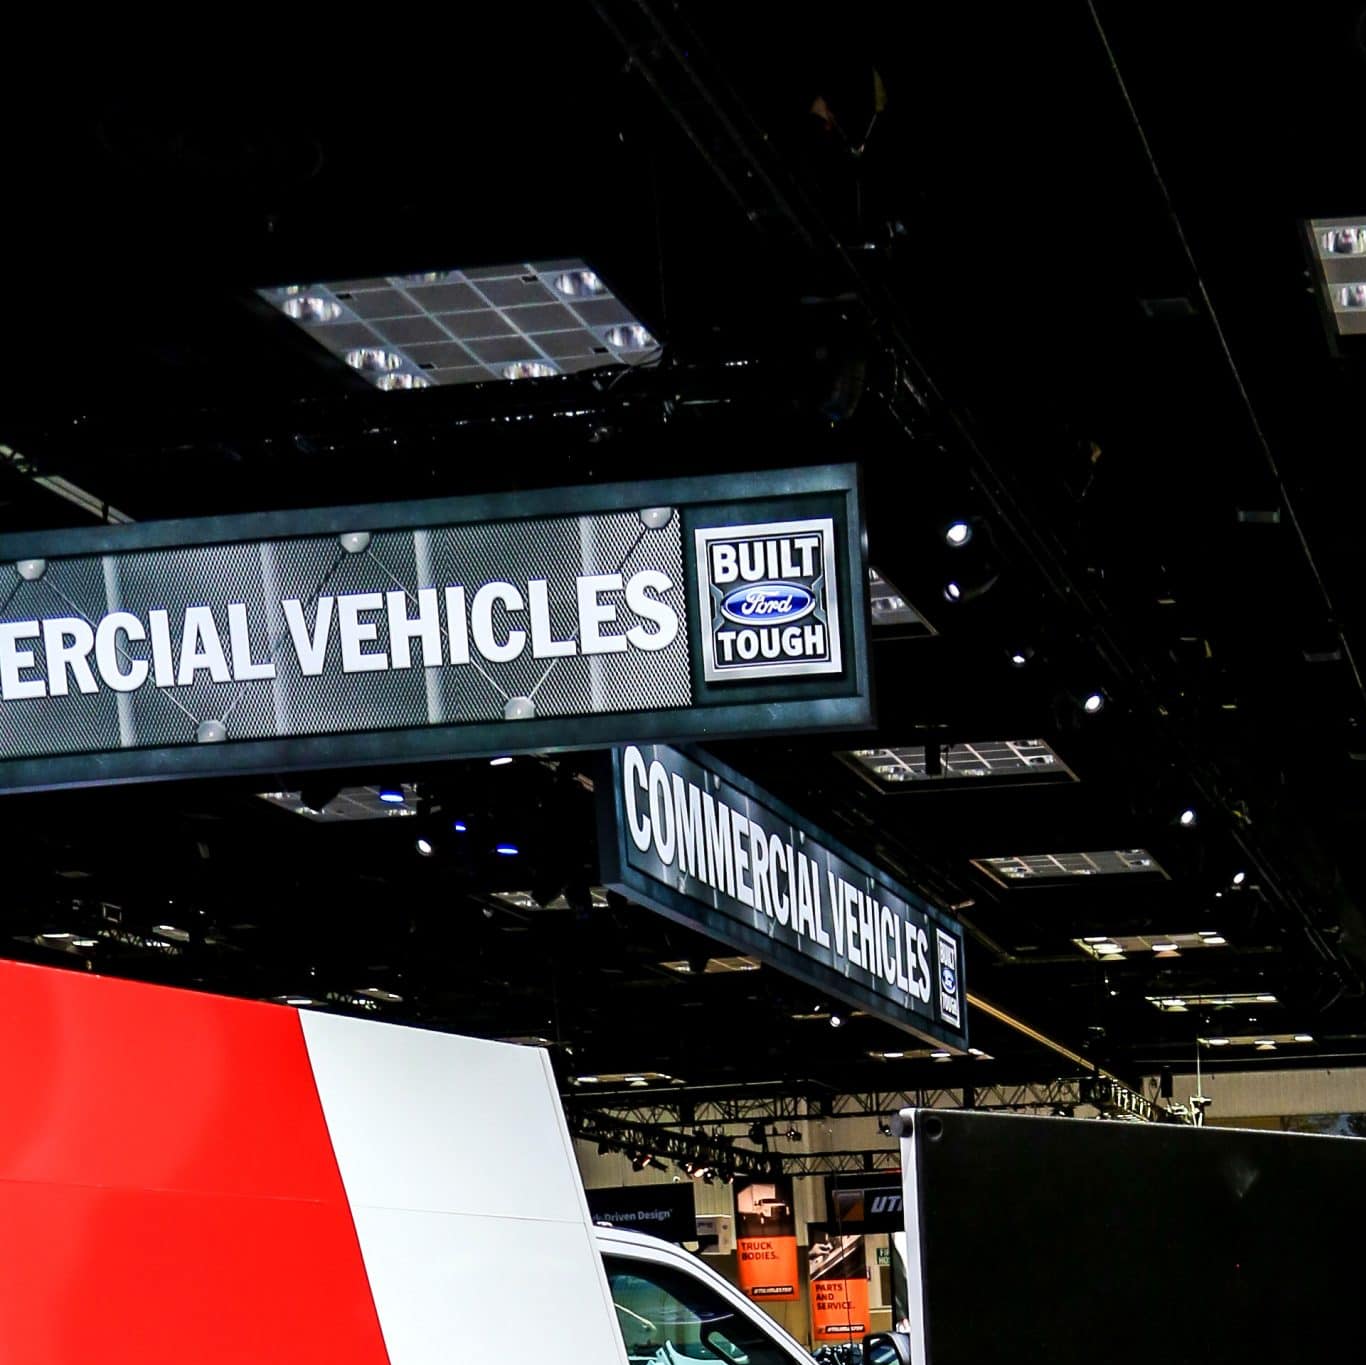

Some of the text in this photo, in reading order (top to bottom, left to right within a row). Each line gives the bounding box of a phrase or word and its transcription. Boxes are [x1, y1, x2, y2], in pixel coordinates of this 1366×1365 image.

[712, 537, 819, 583] BUILT
[741, 590, 793, 615] Ford
[0, 570, 679, 700] ERCIAL VEHICLES
[718, 625, 824, 661] TOUGH
[623, 745, 931, 1004] COMMERCIAL VEHICLES
[741, 1241, 773, 1251] TRUCK
[815, 1283, 843, 1291] PARTS
[815, 1293, 834, 1301] AND
